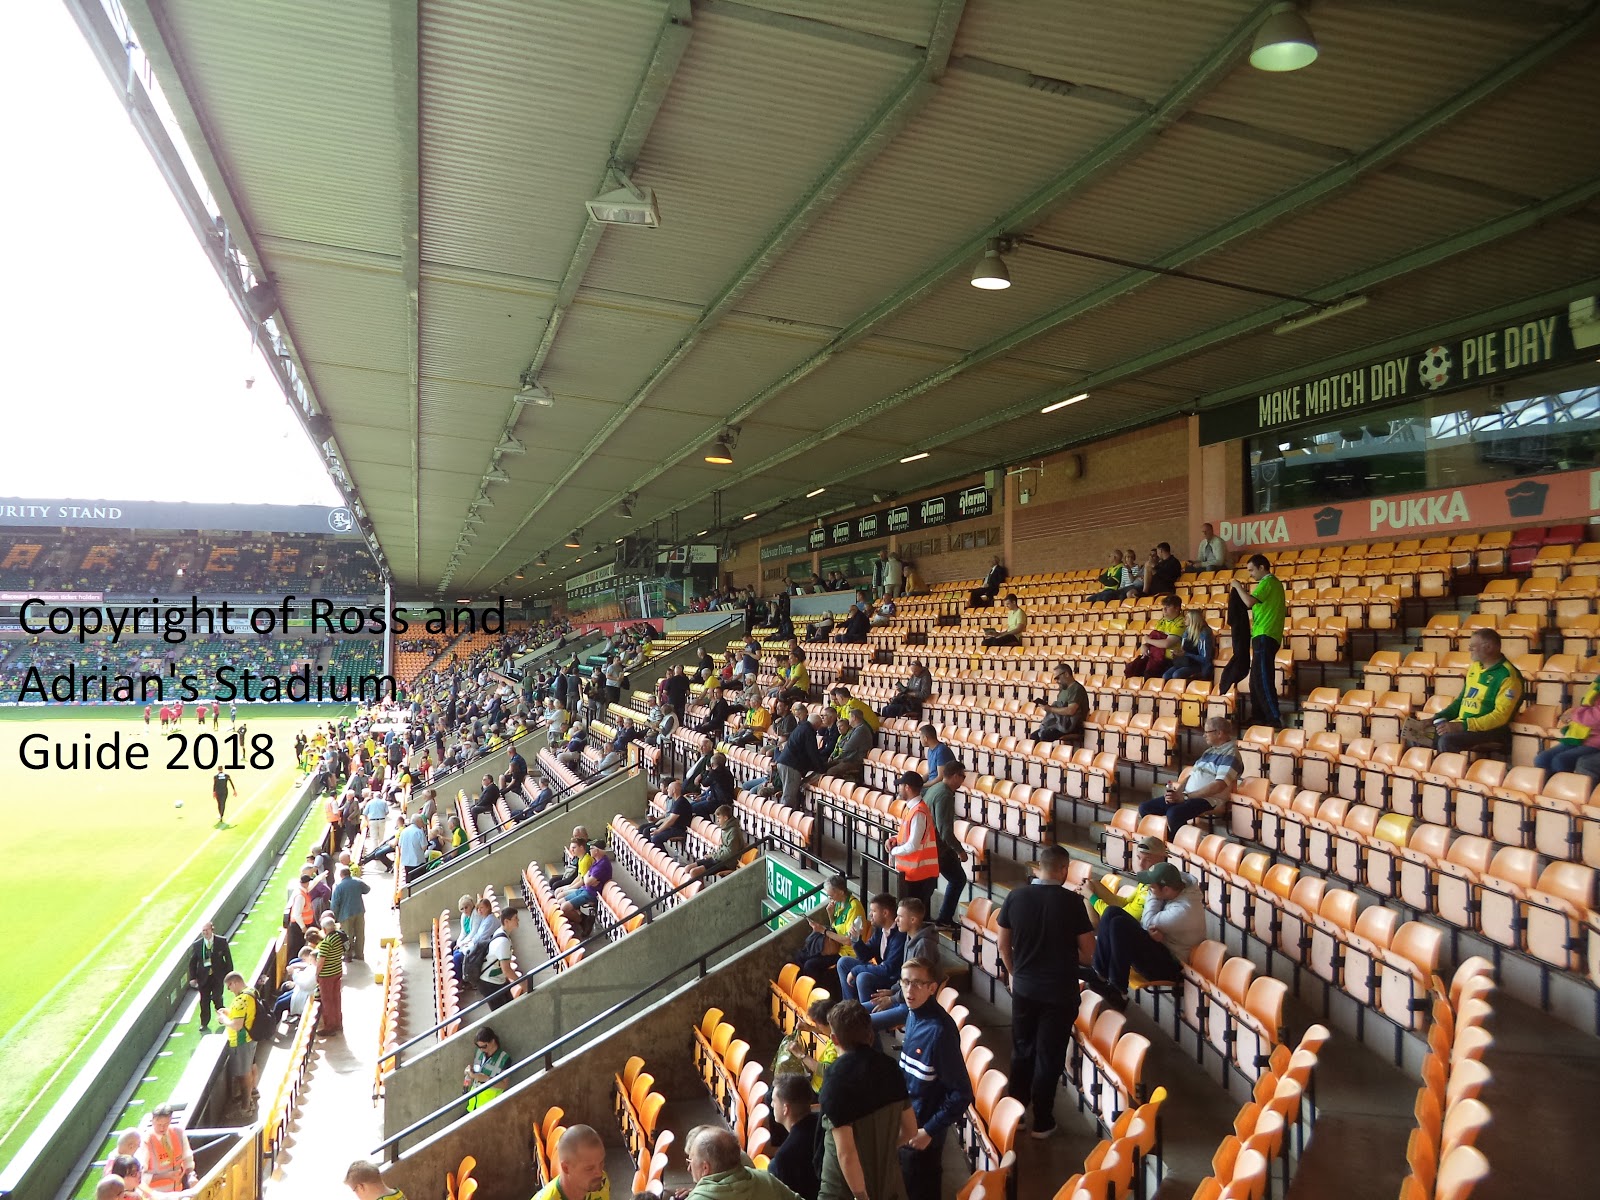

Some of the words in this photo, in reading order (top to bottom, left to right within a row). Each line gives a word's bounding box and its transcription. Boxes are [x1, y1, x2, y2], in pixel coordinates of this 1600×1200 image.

[1258, 395, 1301, 428] MAKE
[1305, 370, 1365, 418] MATCH
[1371, 357, 1413, 402] DAY
[1462, 333, 1497, 380] PIE
[1504, 316, 1558, 370] DAY
[58, 506, 122, 520] STAND
[1370, 491, 1470, 531] PUKKA
[1219, 516, 1290, 547] PUKKA
[775, 872, 793, 901] EXIT
